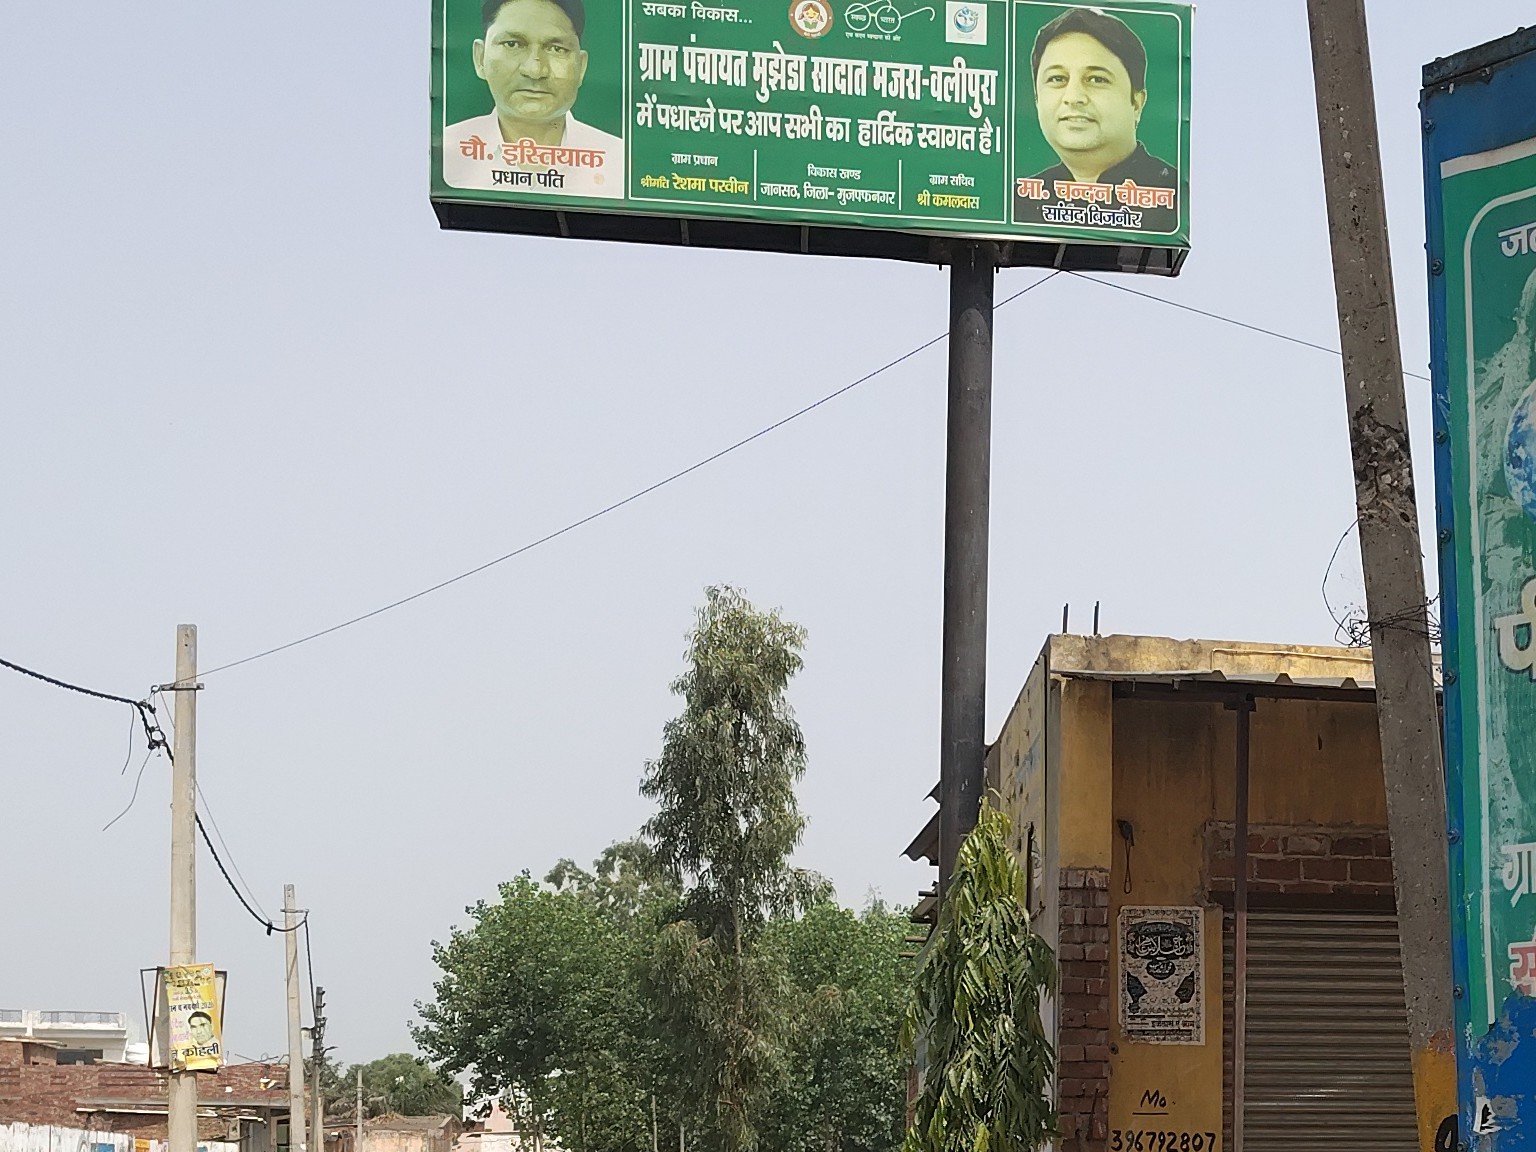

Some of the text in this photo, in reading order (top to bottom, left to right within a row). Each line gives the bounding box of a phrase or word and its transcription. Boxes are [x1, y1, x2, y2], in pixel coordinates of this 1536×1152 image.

[642, 2, 686, 18] सबका
[639, 43, 678, 82] ग्राम
[683, 34, 748, 87] पंचायत
[811, 56, 867, 97] सादात
[636, 93, 657, 128] में
[658, 98, 715, 133] पधारने
[718, 109, 744, 136] पर
[745, 111, 781, 138] आप
[785, 105, 822, 140] सभी
[826, 115, 851, 143] का
[858, 110, 913, 147] हार्दिक
[916, 121, 975, 151] स्वागत
[501, 138, 606, 170] इस्तियाक
[671, 153, 718, 167] ग्राम प्रधान
[492, 168, 565, 189] प्रधान पति
[807, 163, 837, 178] विकास
[929, 173, 974, 187] ग्राम सचिव
[671, 173, 706, 191] रेशमा
[709, 176, 749, 194] परवीन
[1055, 180, 1112, 204] चन्दन
[1117, 179, 1175, 209] चौहान
[917, 189, 980, 209] श्री कमलदास
[1043, 203, 1142, 228] सांसद बिजनौर
